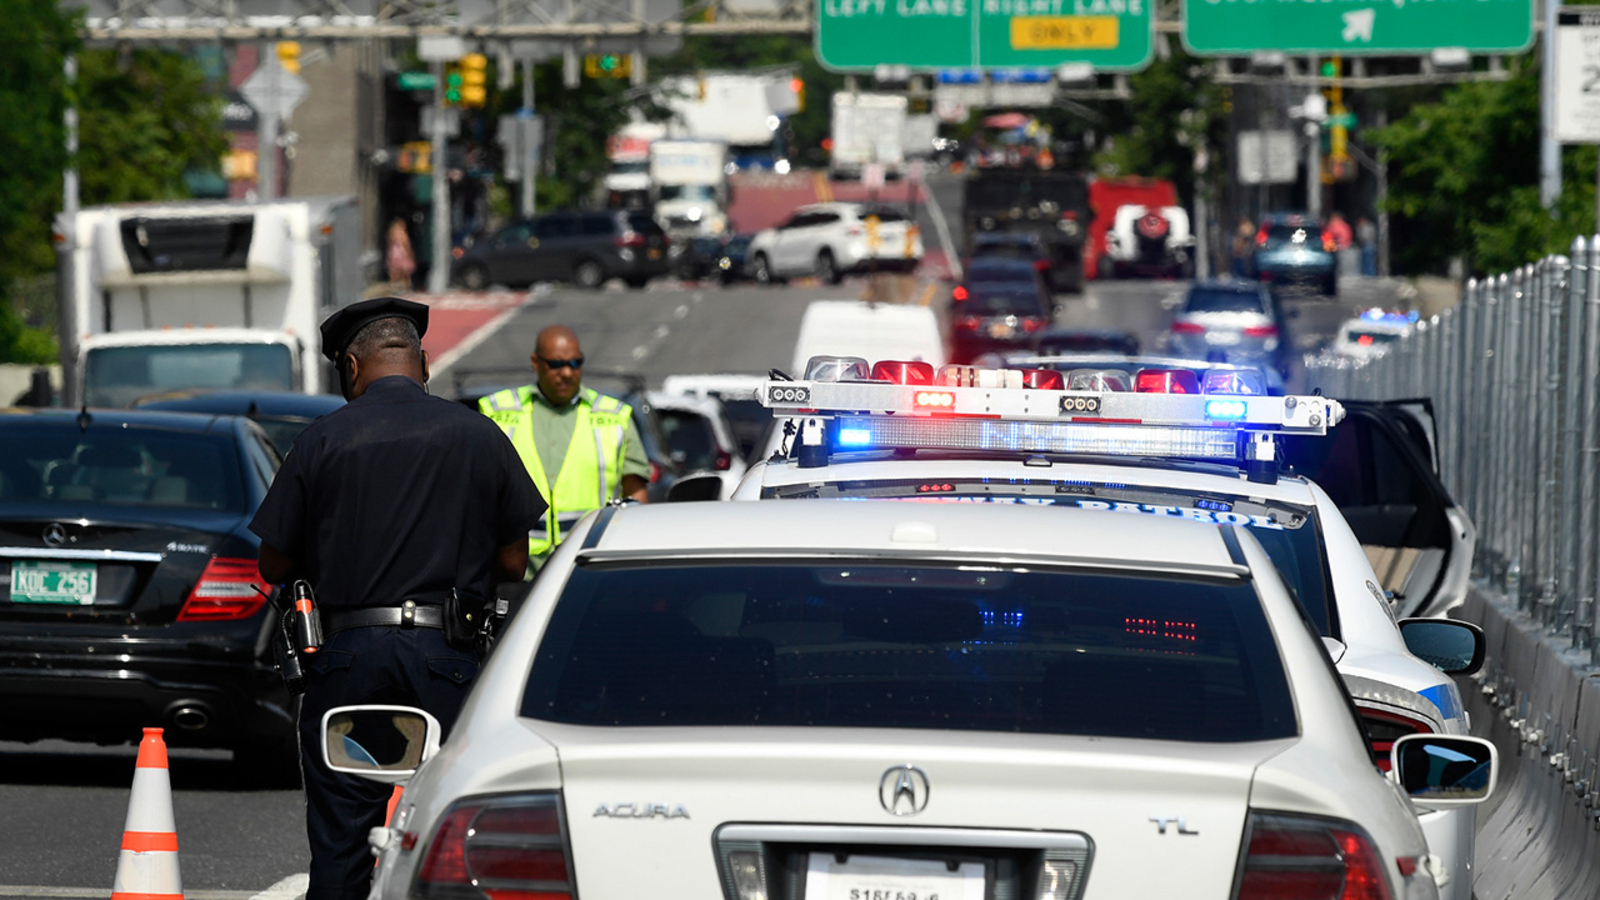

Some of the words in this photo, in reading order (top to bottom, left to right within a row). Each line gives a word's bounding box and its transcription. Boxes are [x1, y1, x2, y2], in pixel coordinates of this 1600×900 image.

[824, 0, 886, 17] LEFT
[897, 0, 968, 17] LANE
[983, 0, 1062, 16] RIGHT
[1074, 0, 1143, 16] LANE
[1029, 20, 1096, 44] ONLY
[1076, 500, 1284, 530] PATROL
[57, 571, 90, 595] 256
[593, 800, 691, 820] ACURA
[1148, 814, 1199, 836] TL
